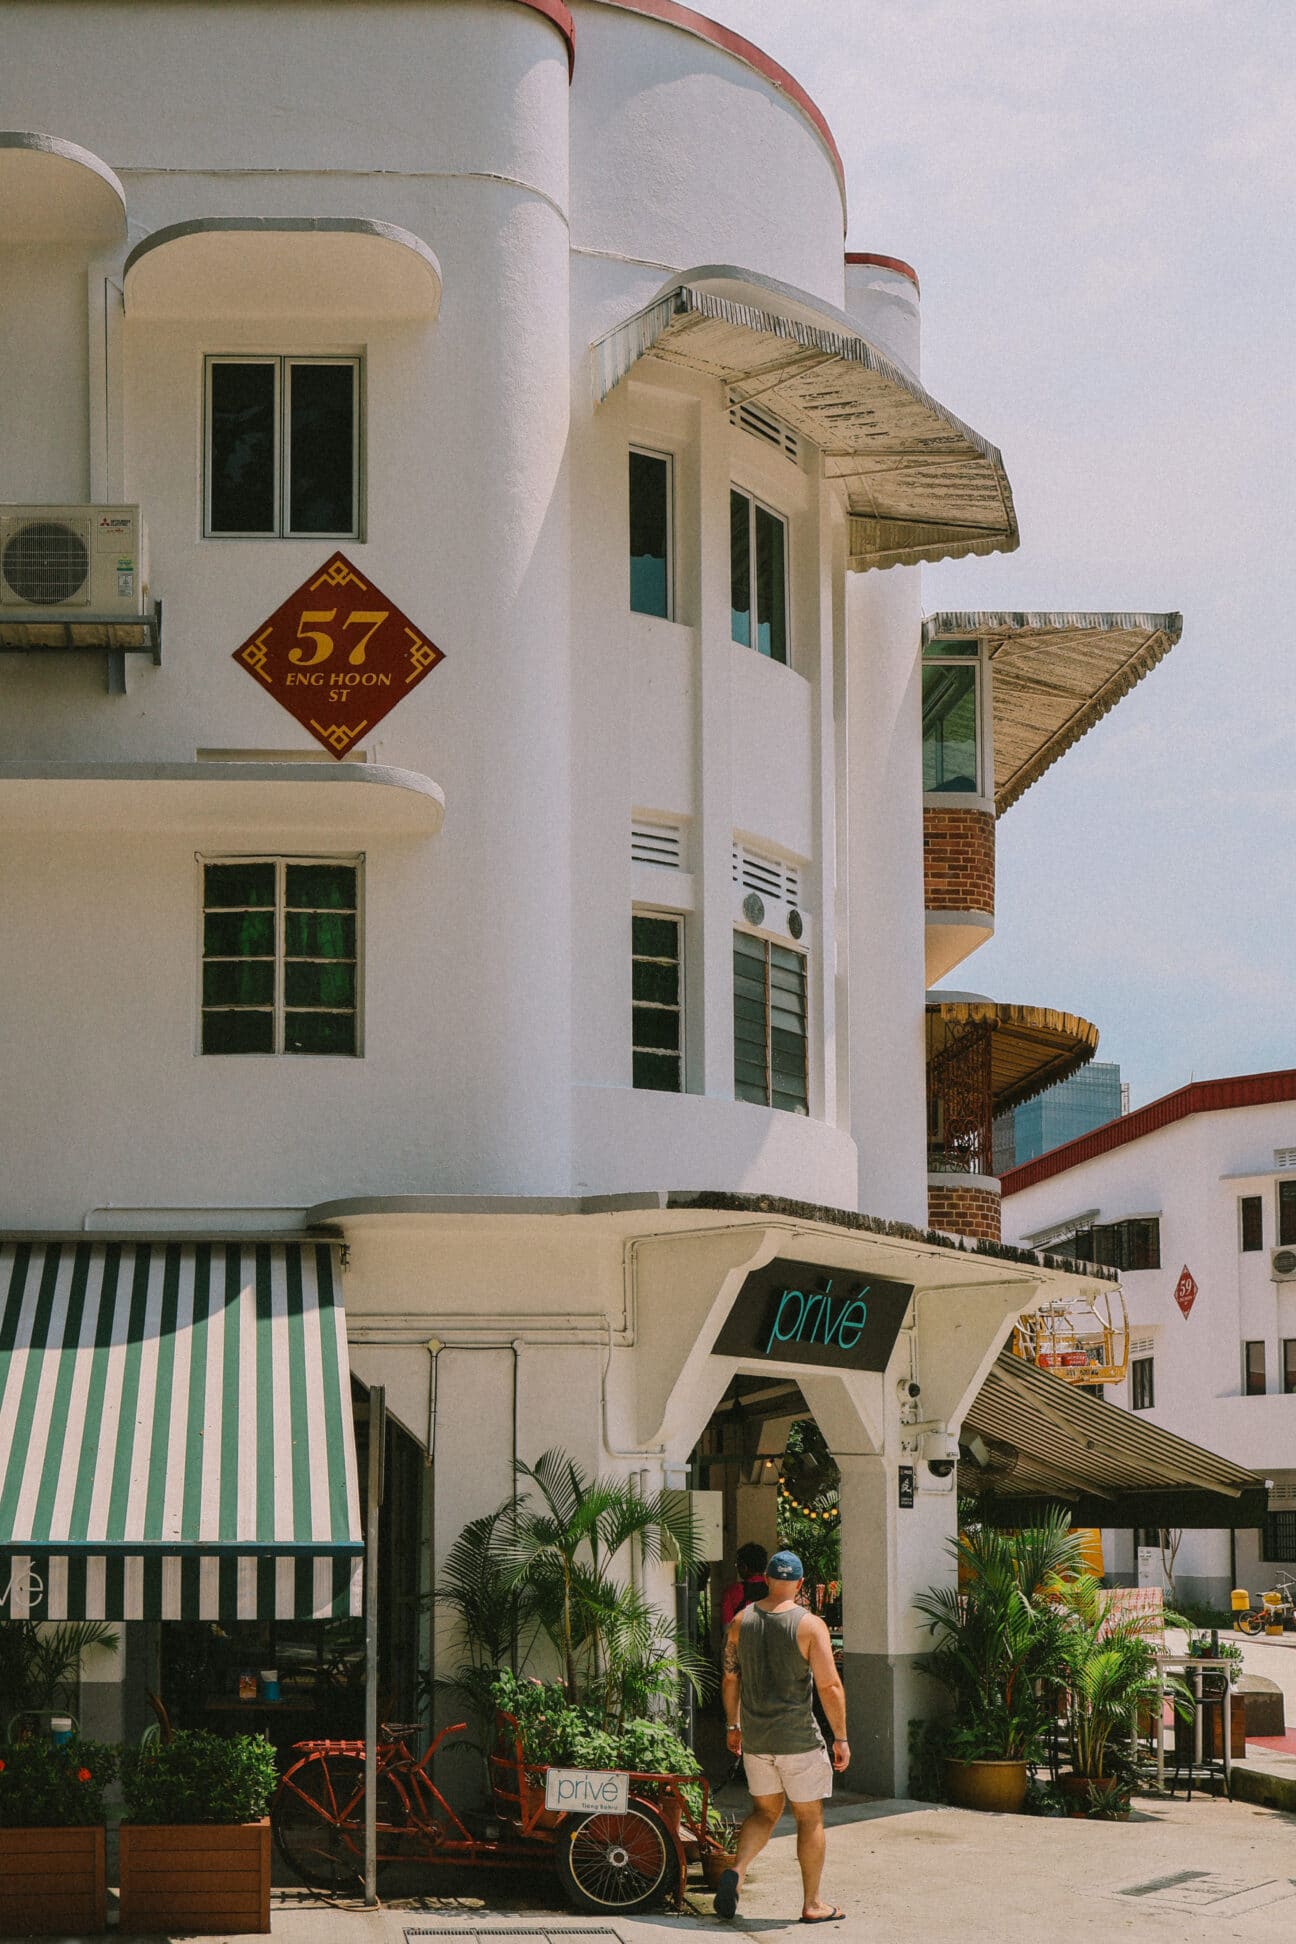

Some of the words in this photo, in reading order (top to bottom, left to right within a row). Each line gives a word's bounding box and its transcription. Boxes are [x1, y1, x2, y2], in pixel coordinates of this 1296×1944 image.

[287, 607, 390, 666] 57
[286, 672, 325, 686] ENG
[329, 672, 392, 686] HOON
[328, 689, 351, 702] ST
[1179, 1278, 1192, 1297] 59
[765, 1279, 871, 1355] privé
[557, 1774, 619, 1805] privé
